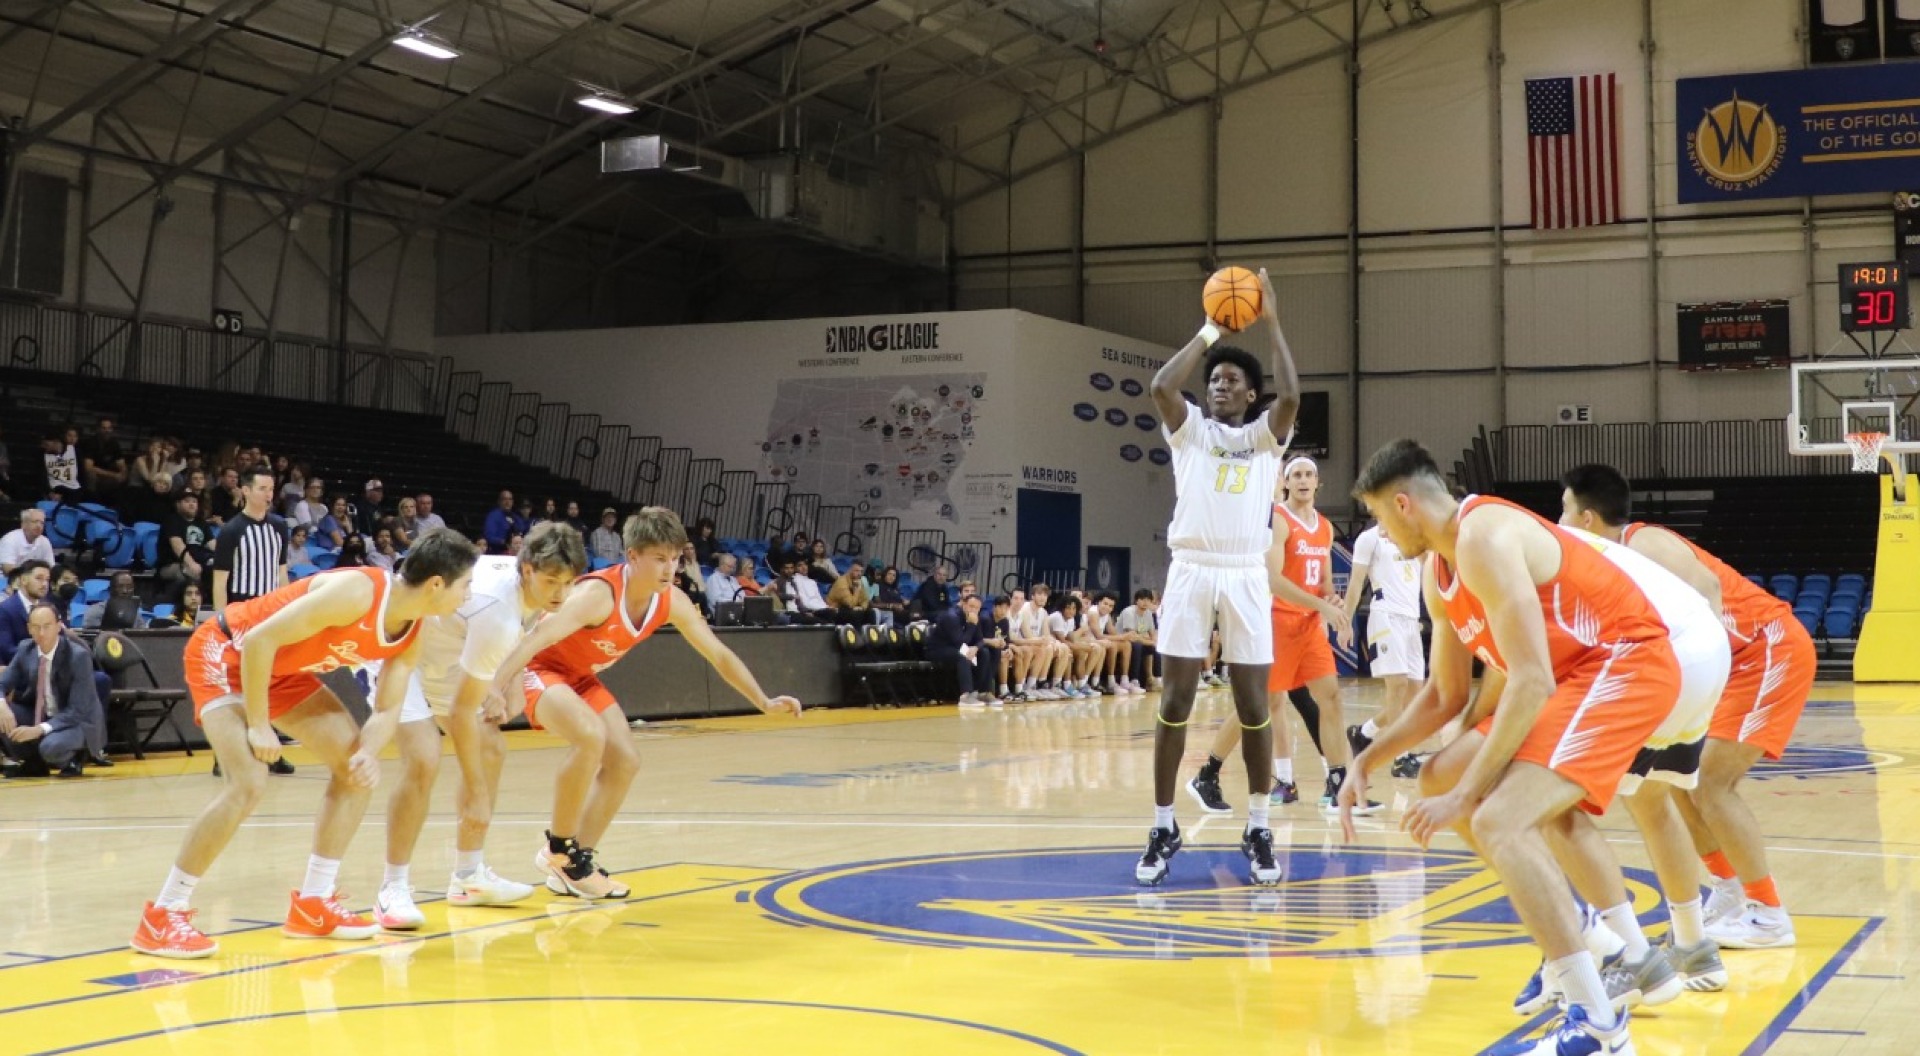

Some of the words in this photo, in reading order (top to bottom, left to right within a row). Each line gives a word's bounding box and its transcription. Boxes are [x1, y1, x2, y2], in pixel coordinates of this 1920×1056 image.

[1803, 118, 1836, 132] THE
[1841, 113, 1919, 130] OFFICIAL
[1820, 136, 1844, 150] OF
[1850, 133, 1885, 148] THE
[1687, 131, 1705, 176] SANTA
[1706, 176, 1743, 192] CRUZ
[1747, 125, 1787, 189] WARRIORS
[1853, 267, 1898, 285] 19:01
[1857, 290, 1895, 324] 30
[231, 317, 242, 332] D
[1704, 316, 1734, 324] SANTA
[1737, 314, 1762, 322] CRUZ
[838, 325, 867, 353] NBA
[889, 322, 939, 350] LEAGUE
[1701, 322, 1767, 339] FIBER
[1102, 347, 1119, 362] SEA
[1121, 351, 1147, 368] SUITE
[1576, 407, 1589, 422] E
[53, 467, 71, 481] 24
[1022, 465, 1077, 484] WARRIORS
[1214, 463, 1250, 494] 13
[1305, 558, 1321, 586] 13
